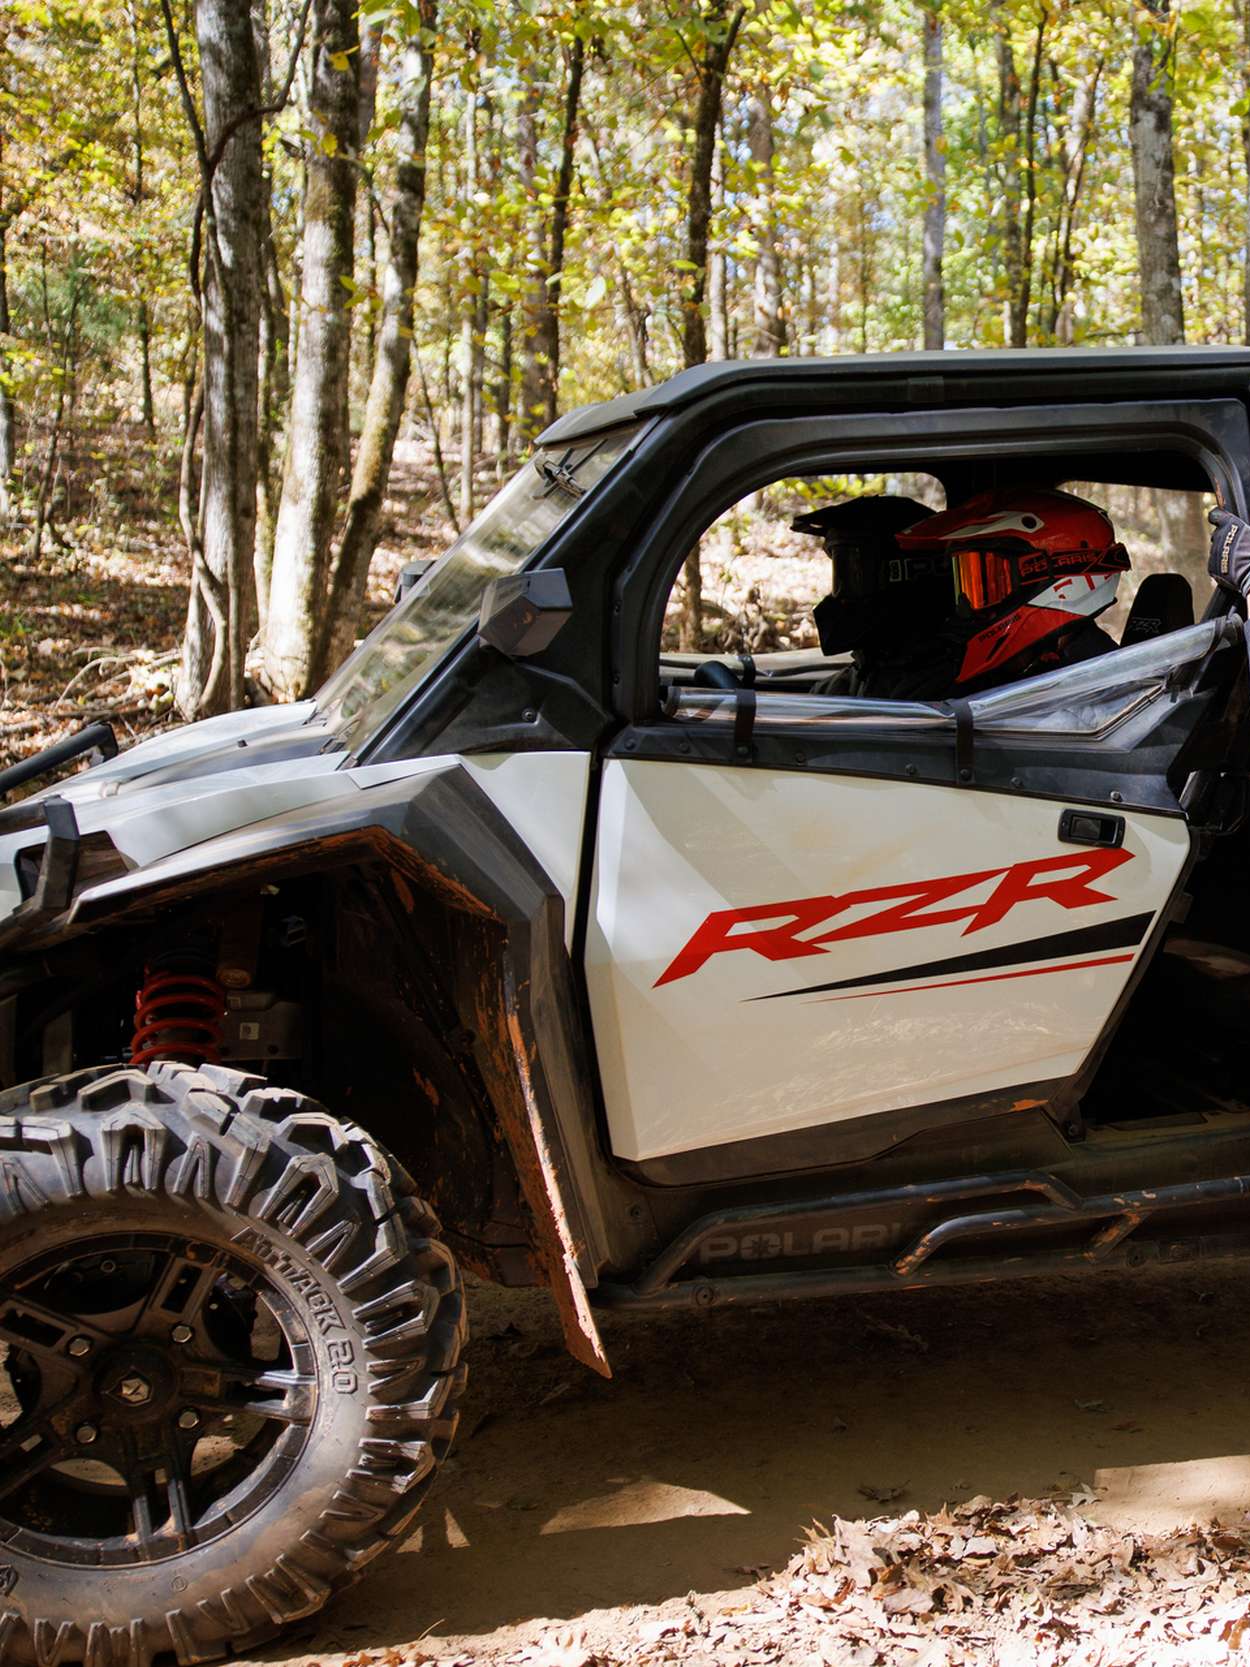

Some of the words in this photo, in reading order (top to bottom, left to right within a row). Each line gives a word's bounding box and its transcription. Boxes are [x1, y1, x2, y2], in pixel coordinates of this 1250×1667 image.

[1021, 550, 1099, 577] POARIS
[652, 847, 1136, 988] RZR
[701, 1222, 905, 1264] POLARI
